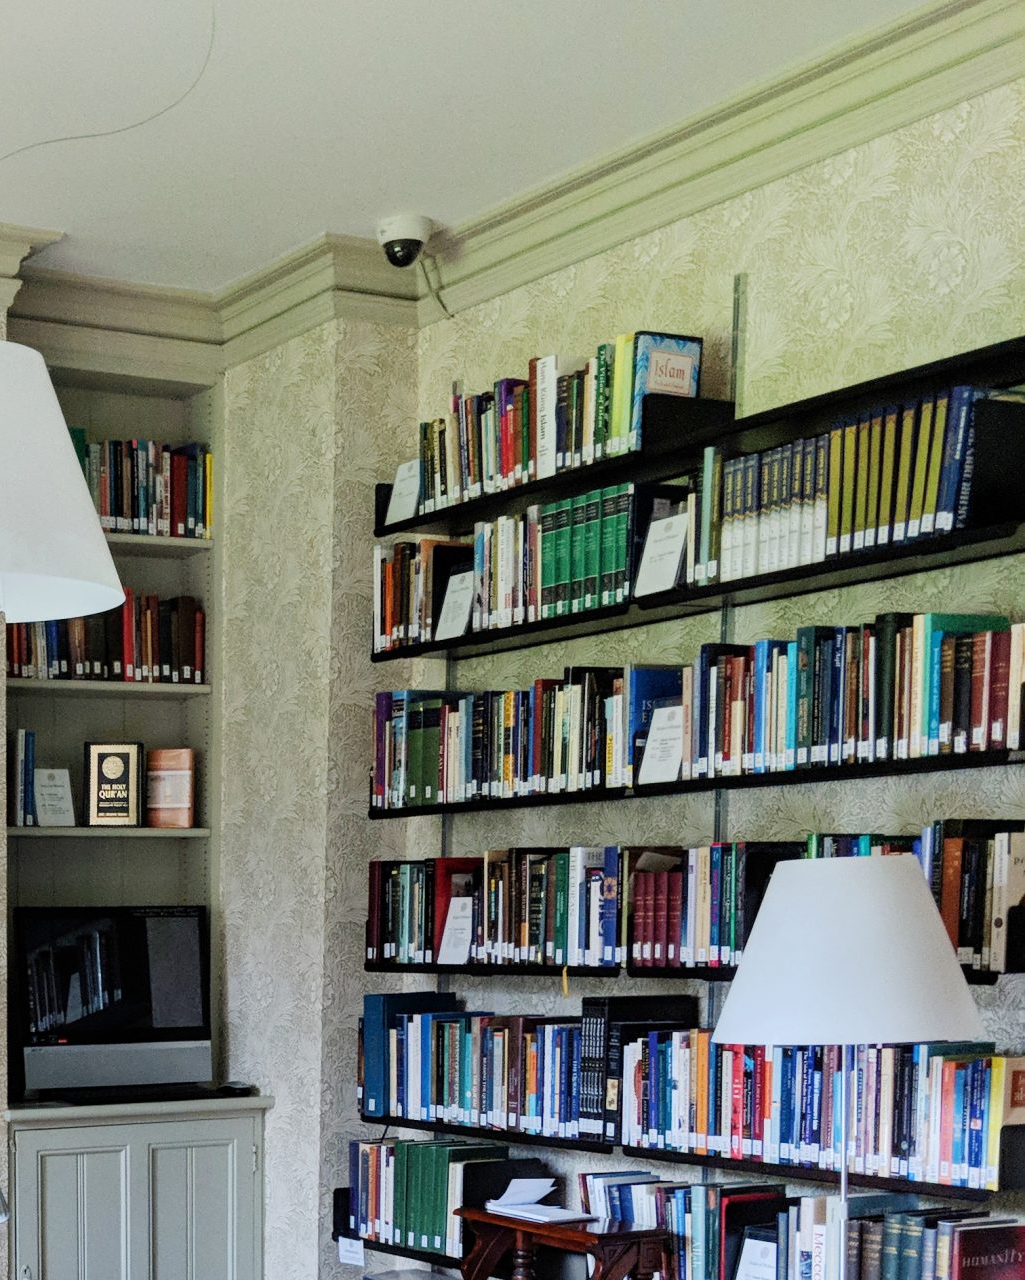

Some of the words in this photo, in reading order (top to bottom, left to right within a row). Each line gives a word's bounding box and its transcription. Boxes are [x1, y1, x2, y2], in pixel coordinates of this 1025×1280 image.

[654, 359, 685, 381] Islam
[540, 414, 548, 441] Islam
[98, 790, 128, 799] QUR'AN
[692, 1240, 703, 1269] Allah
